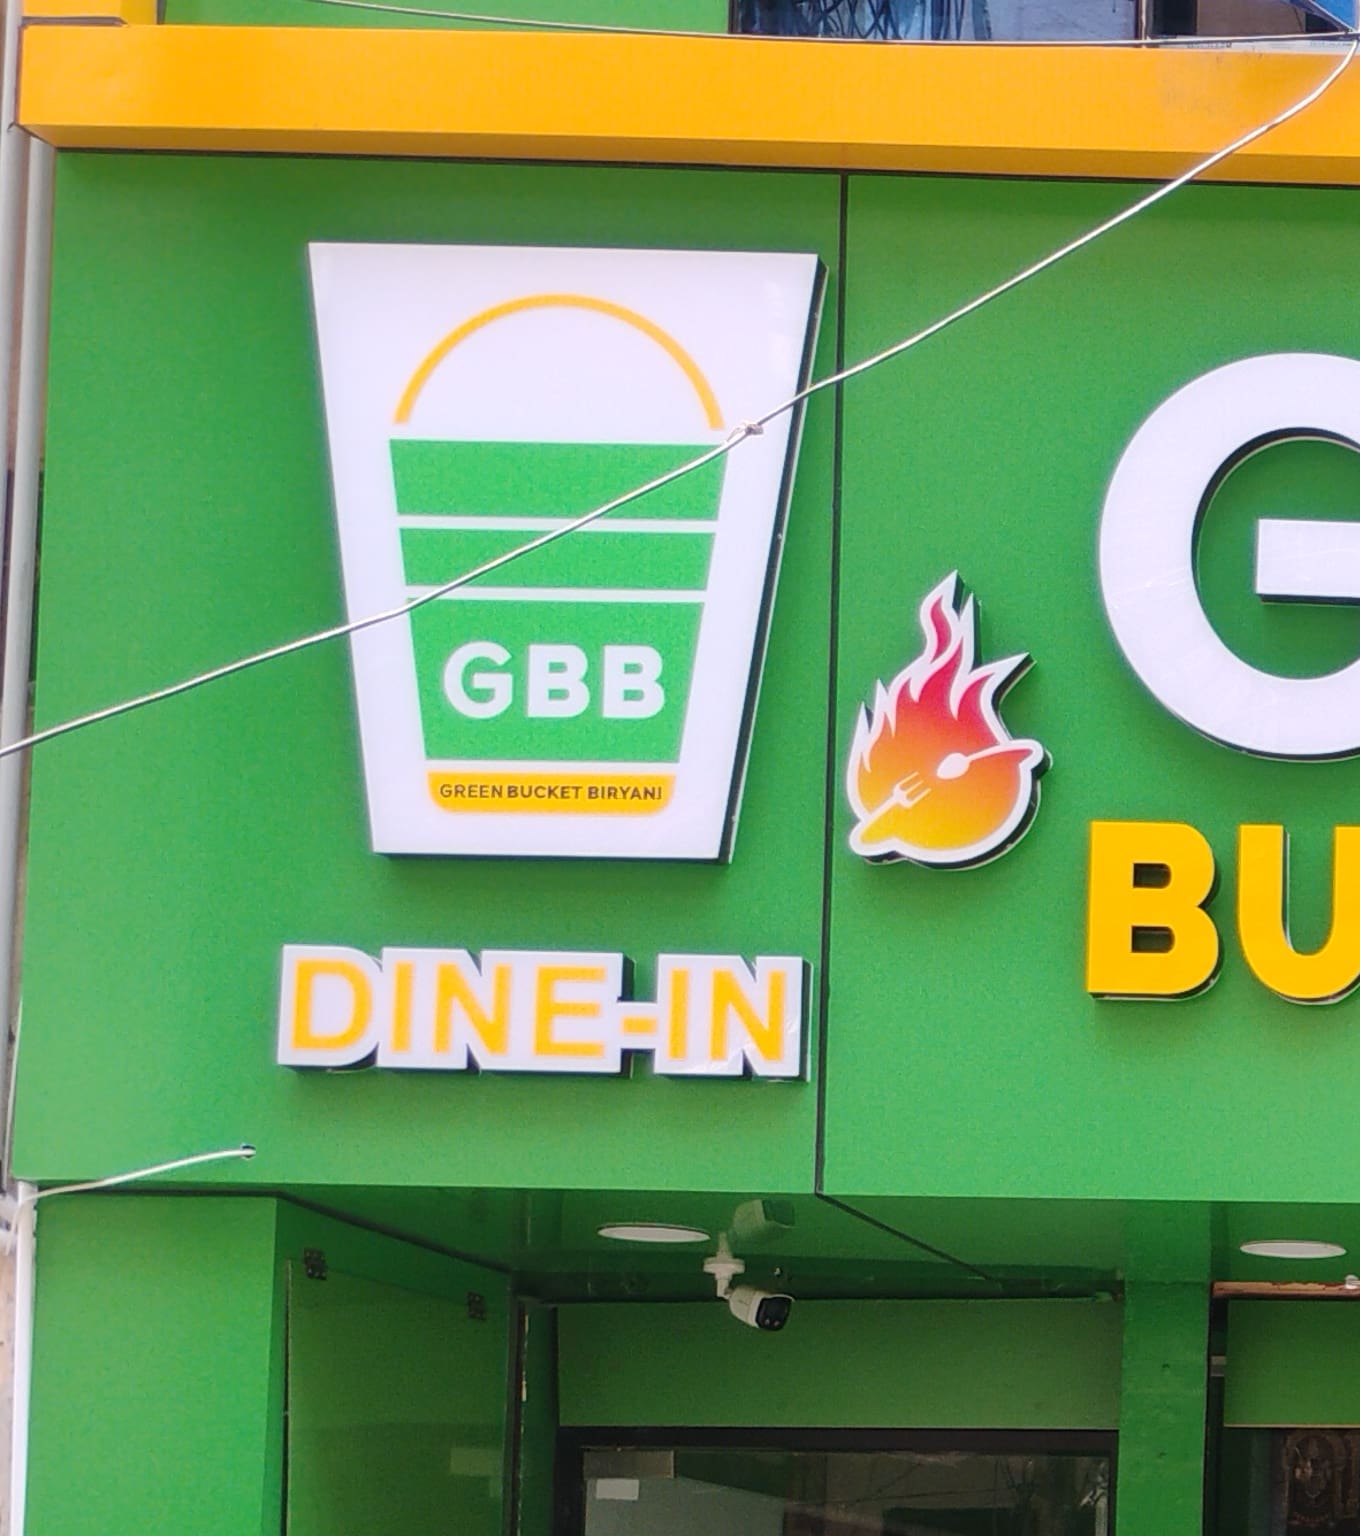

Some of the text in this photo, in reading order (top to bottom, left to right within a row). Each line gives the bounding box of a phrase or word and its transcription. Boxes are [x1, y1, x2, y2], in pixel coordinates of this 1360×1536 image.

[443, 640, 666, 720] GBB
[439, 783, 662, 801] GREEN BUCKET BIRYANI
[281, 949, 803, 1073] DINE-IN
